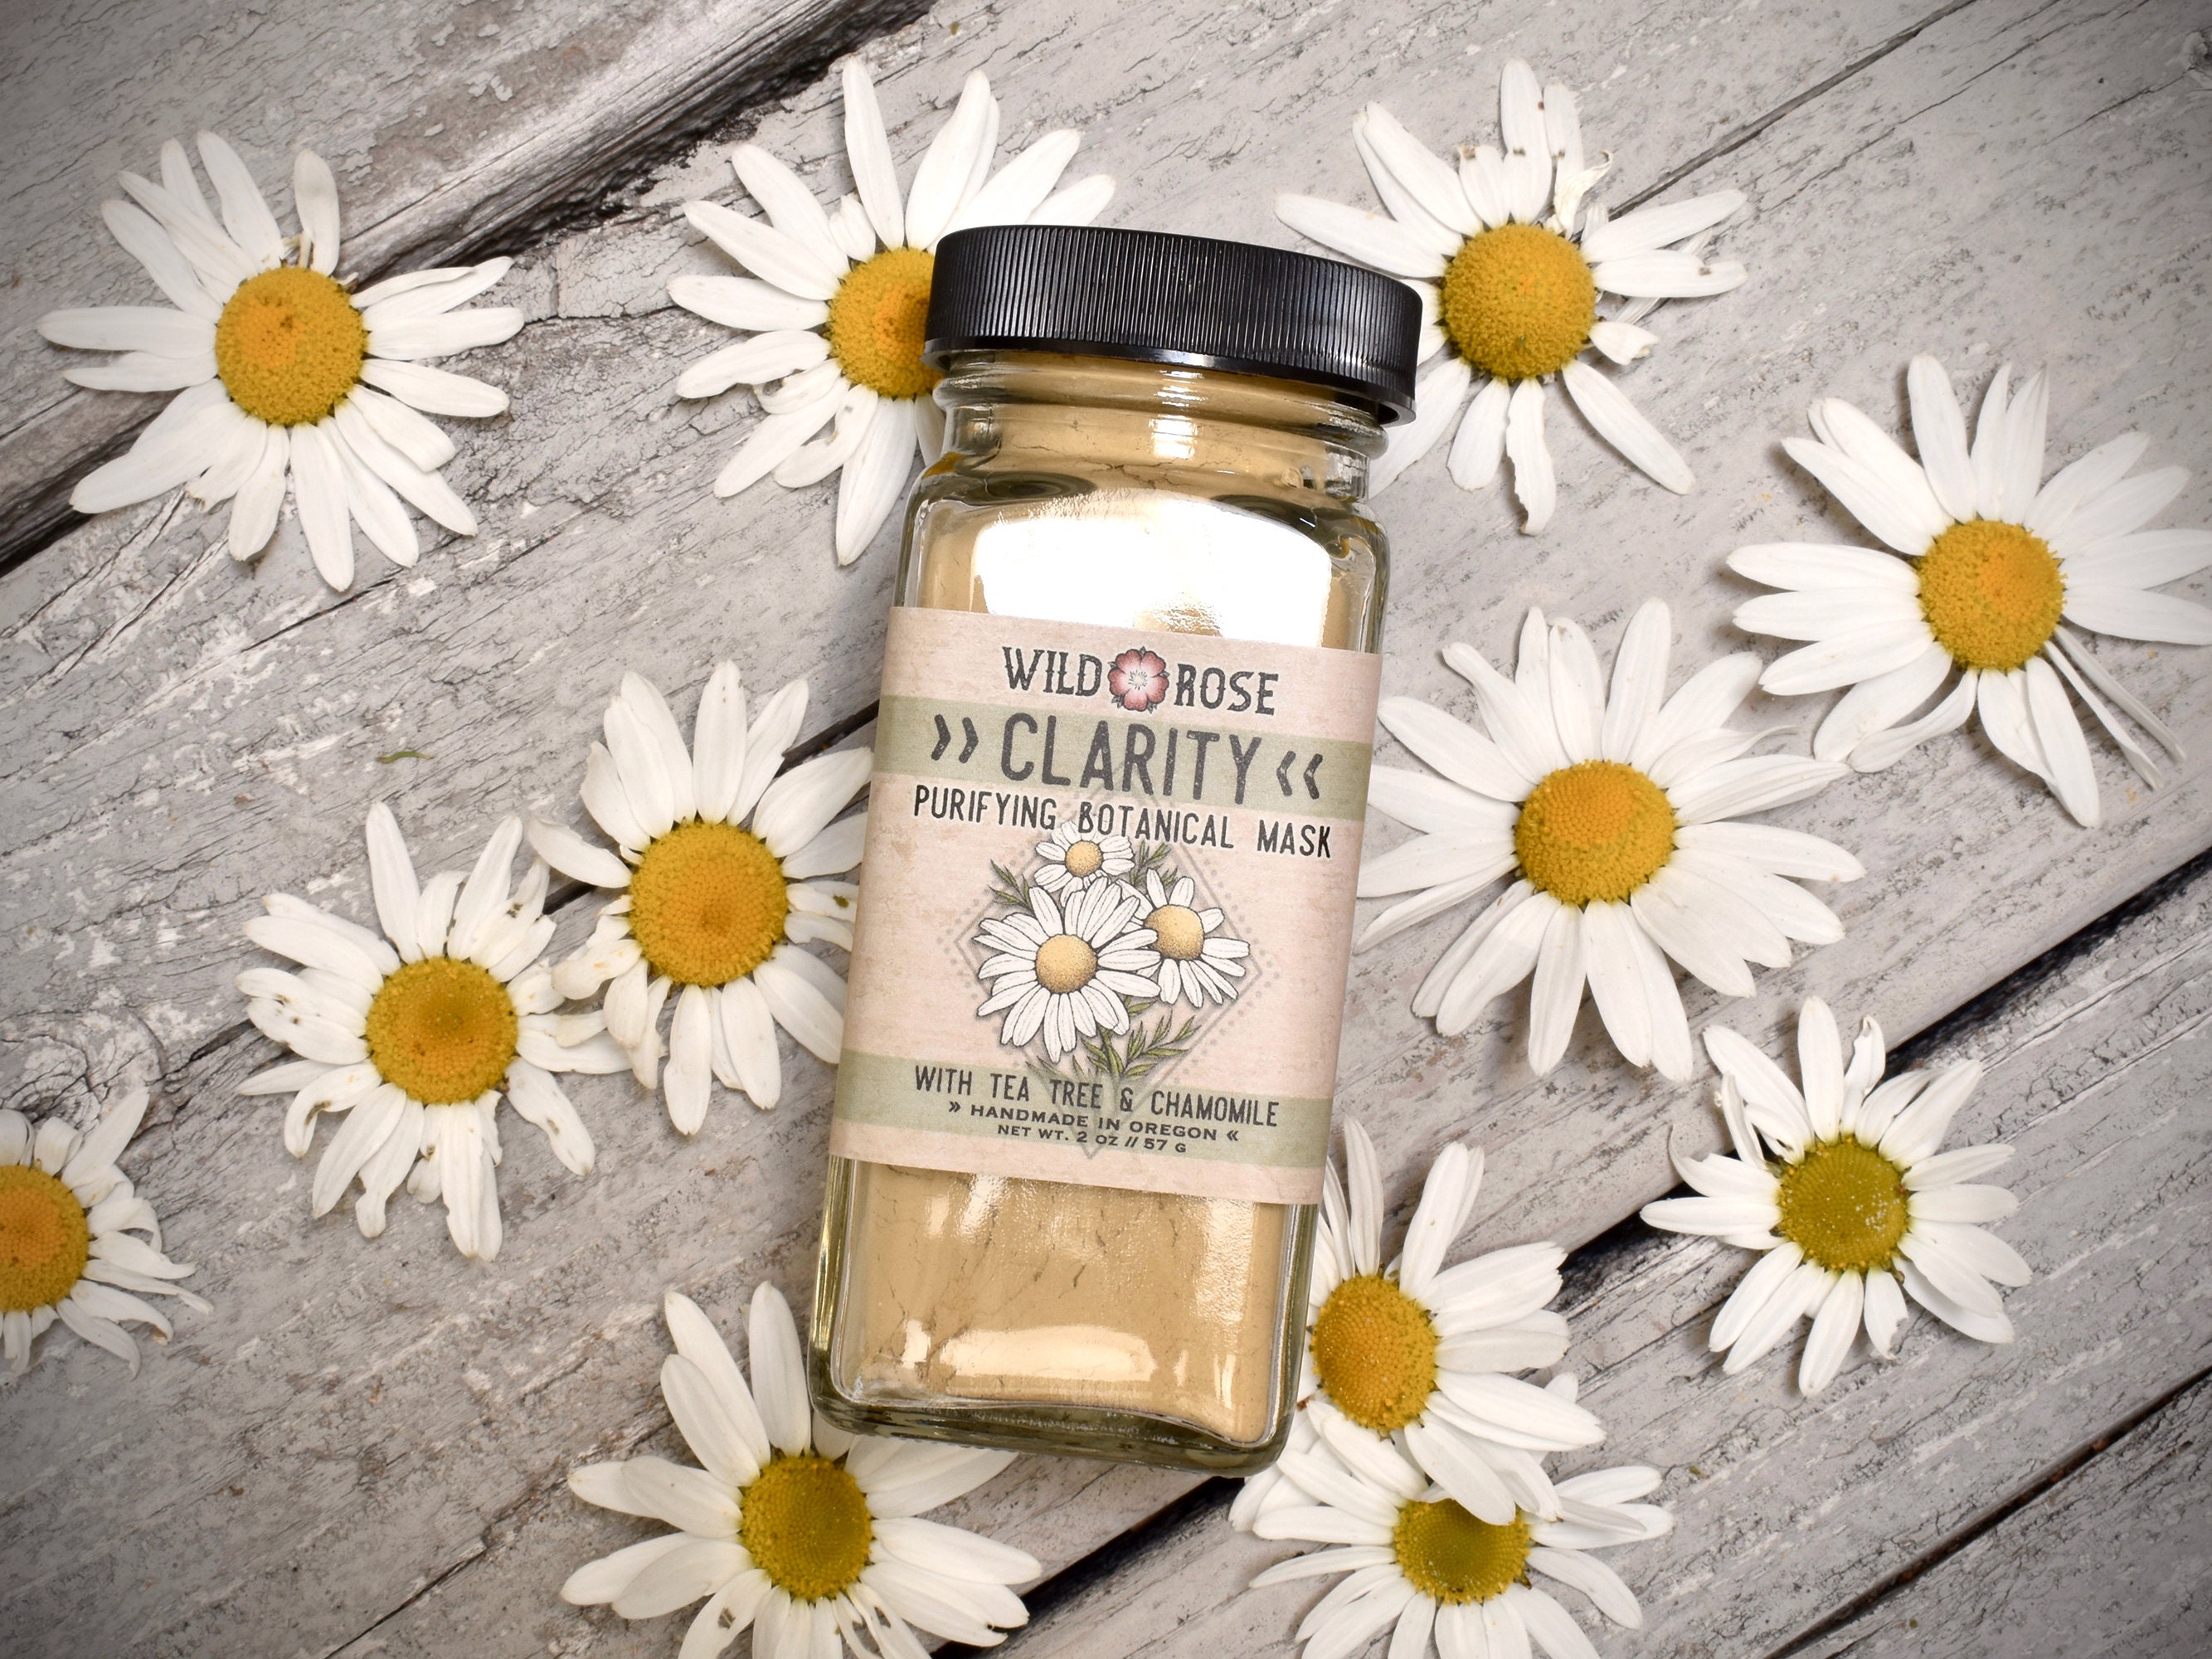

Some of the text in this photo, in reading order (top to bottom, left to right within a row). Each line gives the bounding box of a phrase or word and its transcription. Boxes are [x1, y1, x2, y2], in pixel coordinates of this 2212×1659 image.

[1002, 646, 1279, 716] WILD ROSE
[1000, 712, 1262, 805] CLARITY
[914, 784, 1332, 859] PURIFYING BOTANICAL MASK
[914, 1065, 1280, 1127] WITH TEA TREE & CHAMOMILE
[970, 1104, 1218, 1141] HANDMADE IN OREGON
[997, 1124, 1187, 1154] NET WT. 2 OZ // 57 G
